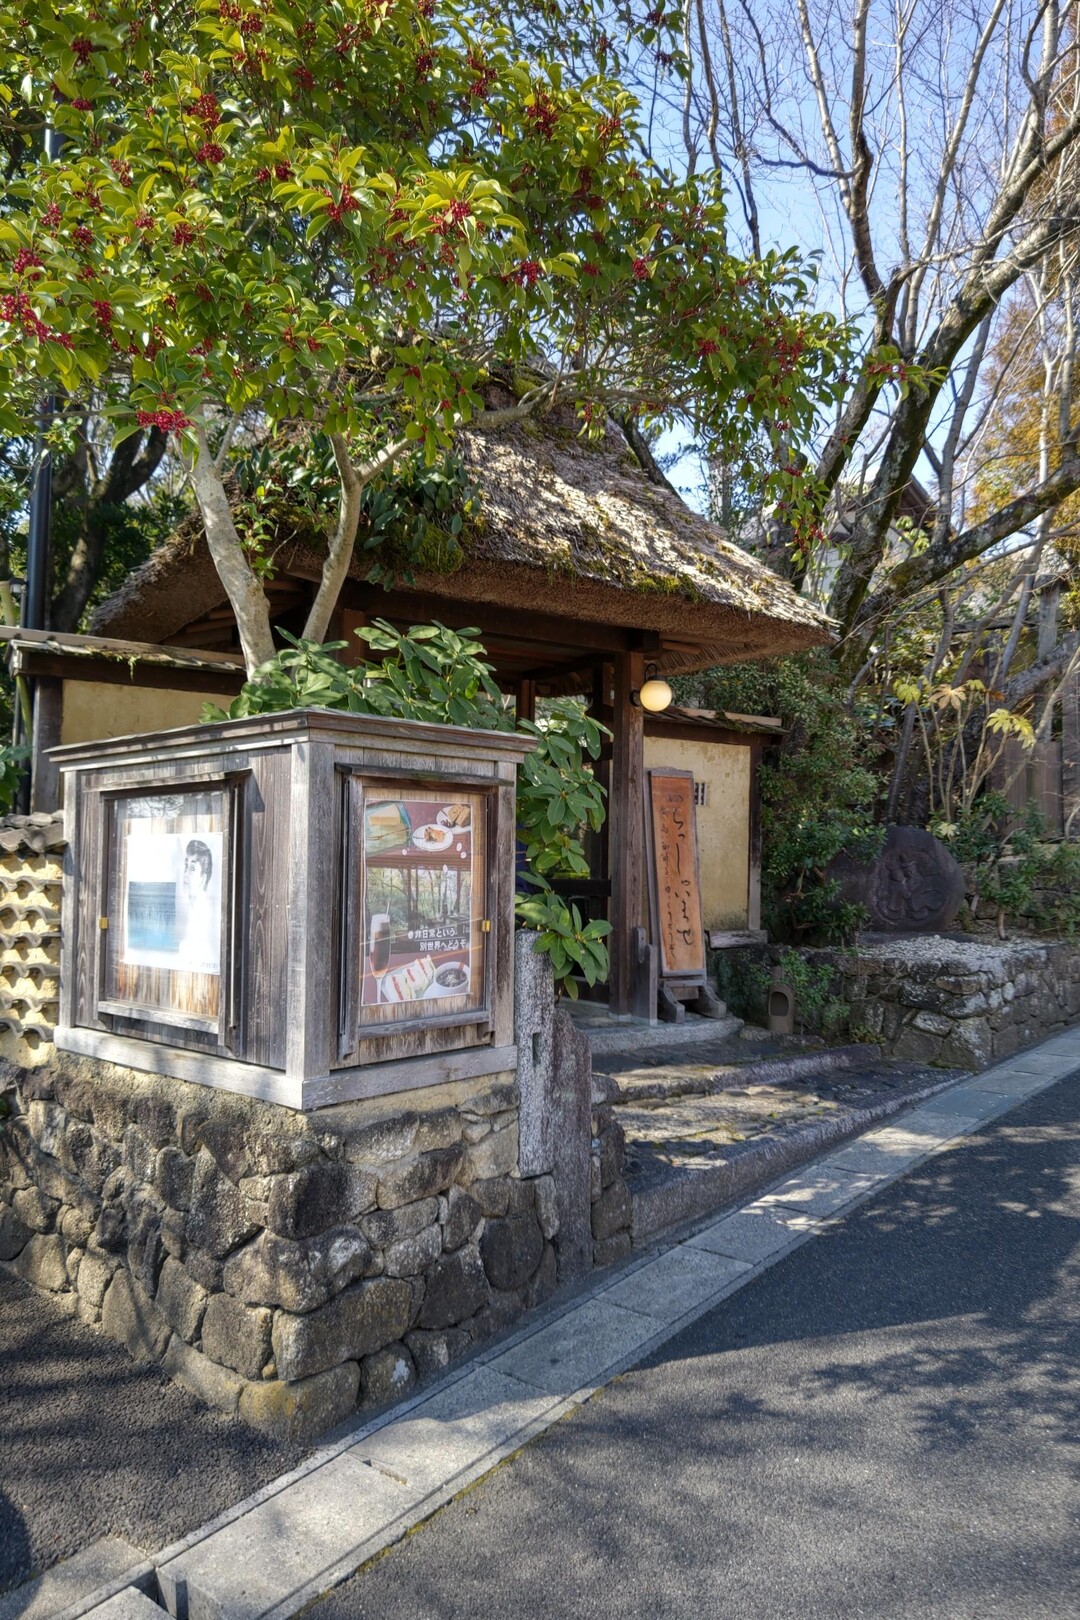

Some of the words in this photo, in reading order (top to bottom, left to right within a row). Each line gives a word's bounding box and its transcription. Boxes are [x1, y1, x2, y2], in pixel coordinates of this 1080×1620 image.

[419, 938, 467, 951] 別世界へどうぞ
